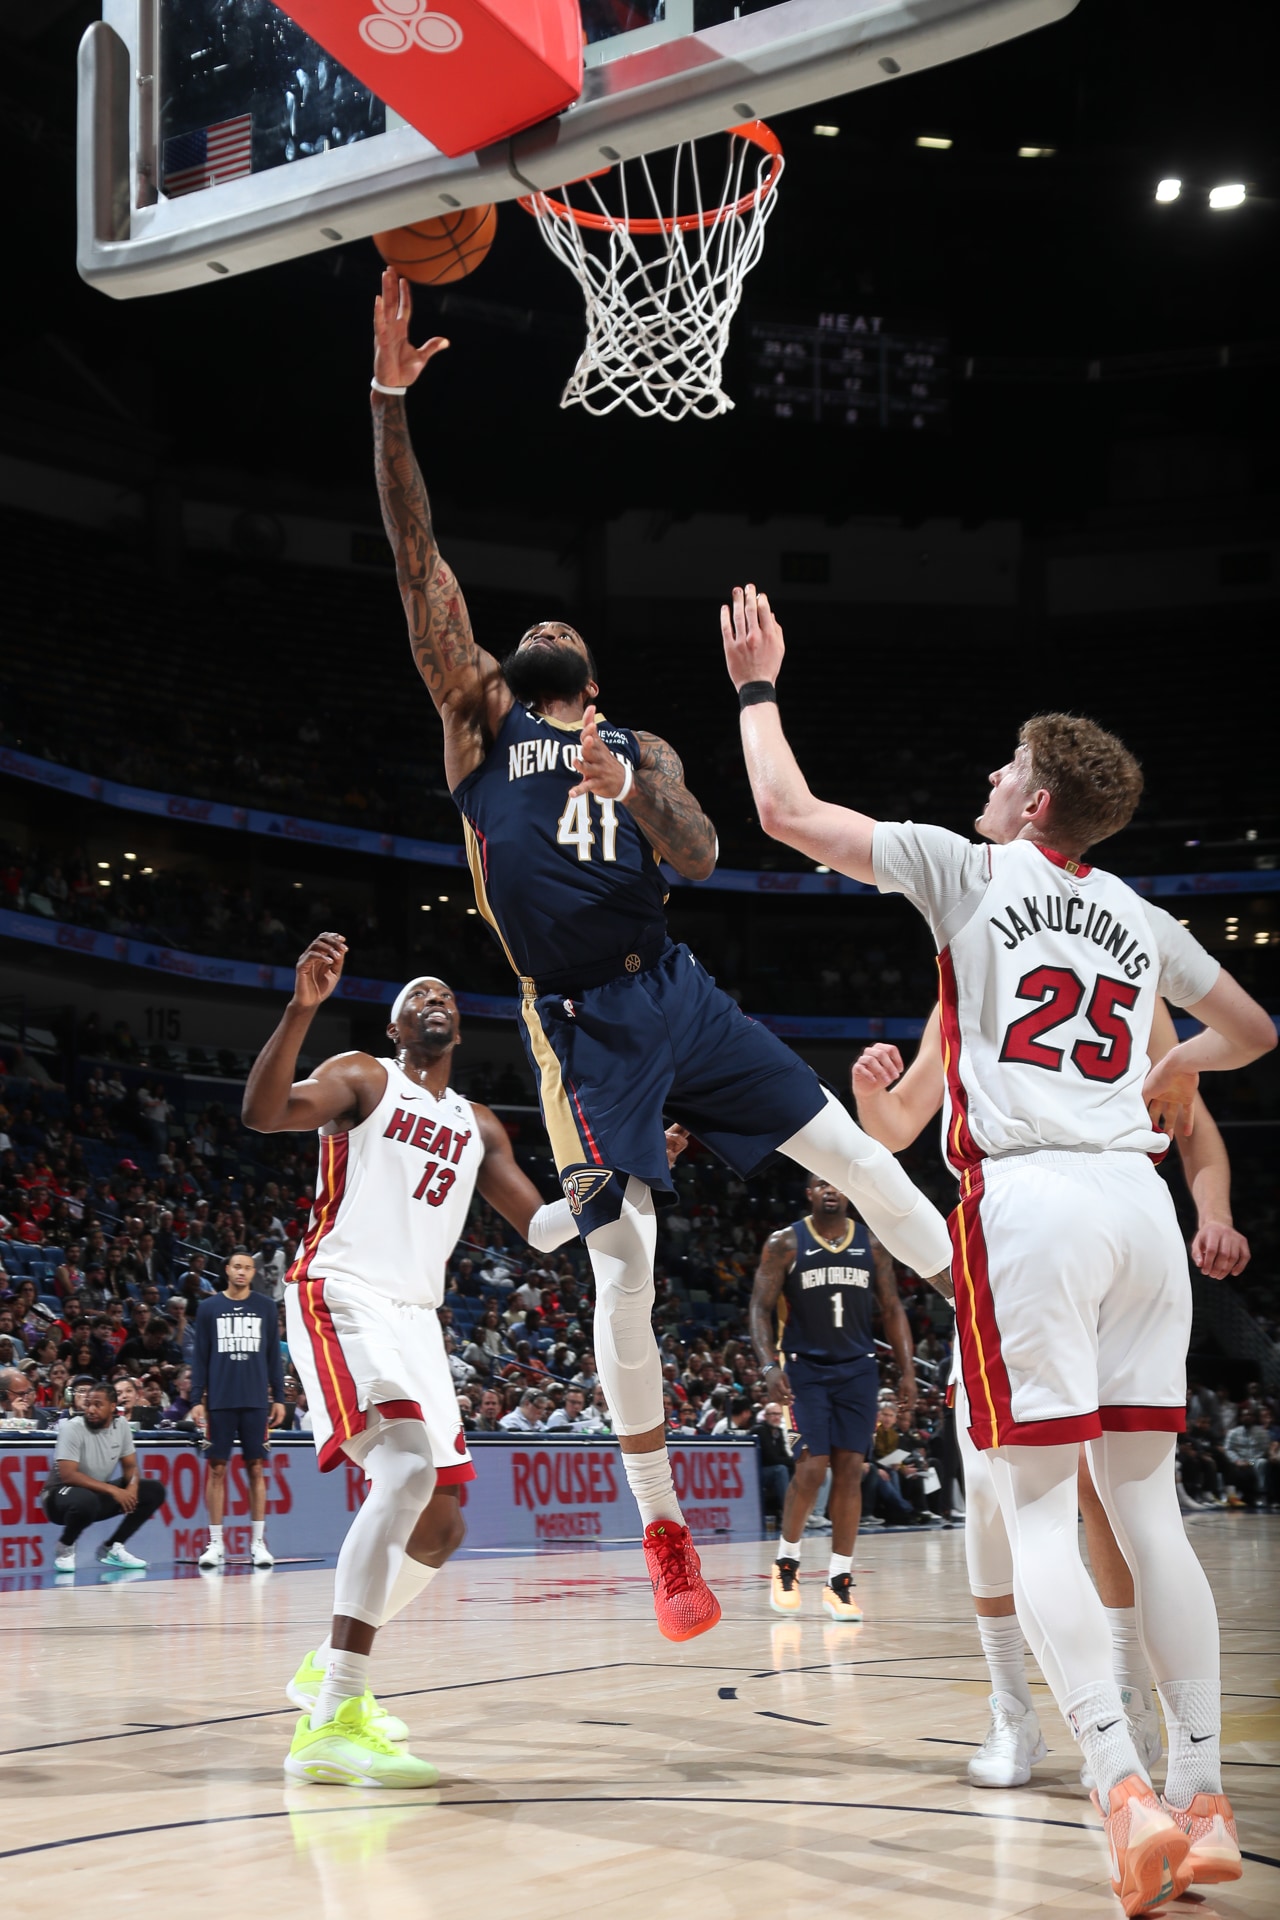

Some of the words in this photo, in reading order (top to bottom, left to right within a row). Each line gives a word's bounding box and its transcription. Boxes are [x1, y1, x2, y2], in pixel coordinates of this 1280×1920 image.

[818, 312, 884, 334] HEAT
[508, 738, 560, 782] NEW
[556, 793, 619, 862] 41
[144, 1006, 181, 1041] 115
[997, 964, 1142, 1084] 25
[382, 1107, 472, 1165] HEAT
[412, 1161, 456, 1207] 13
[801, 1267, 826, 1290] NEW
[827, 1266, 870, 1289] ORLEANS
[216, 1316, 262, 1339] BLACK
[830, 1291, 844, 1328] 1
[217, 1338, 261, 1353] HISTORY
[0, 1455, 50, 1526] SE
[511, 1451, 619, 1511] ROUSES
[671, 1451, 744, 1501] OUSES
[534, 1511, 602, 1539] MARKETS
[683, 1507, 731, 1531] ARKETS
